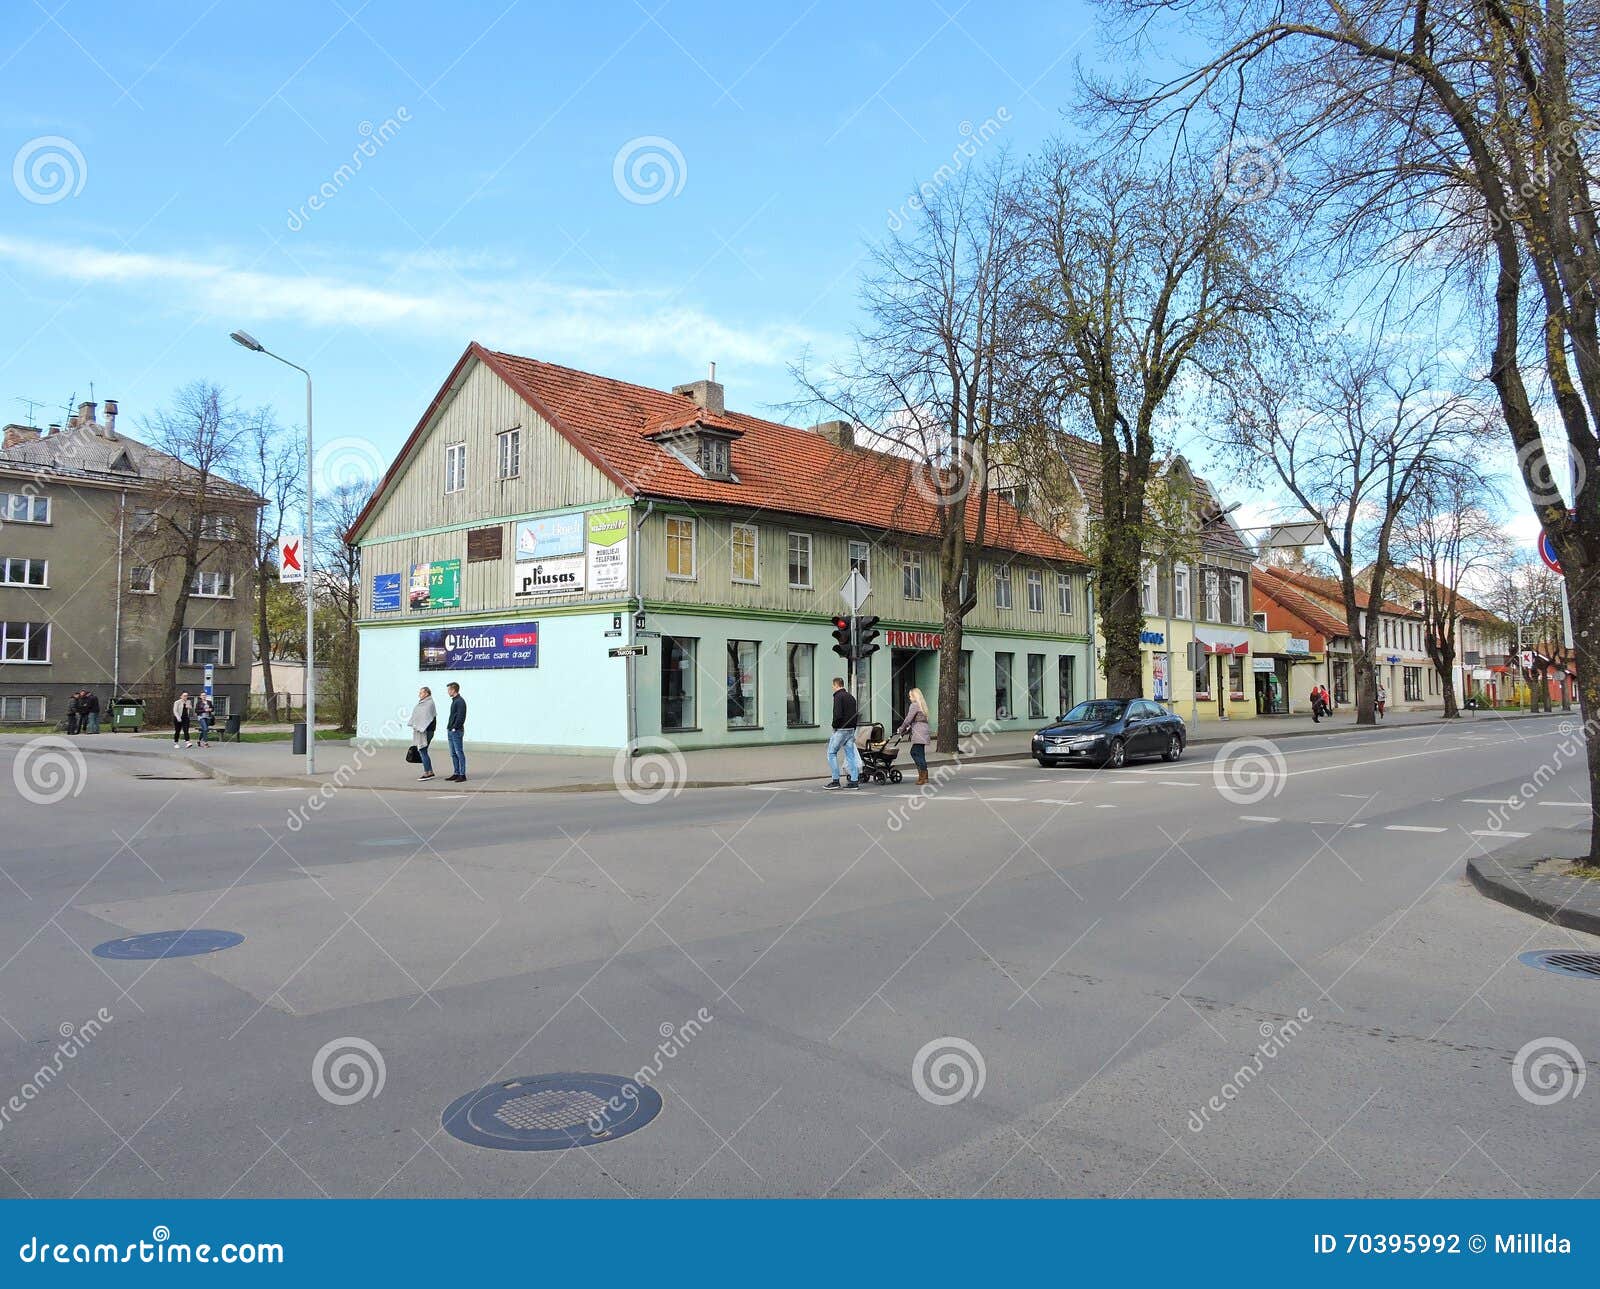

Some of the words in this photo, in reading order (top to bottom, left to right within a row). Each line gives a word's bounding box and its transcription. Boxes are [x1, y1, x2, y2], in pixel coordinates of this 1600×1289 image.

[523, 566, 575, 591] pliusas
[456, 634, 496, 649] Litorina
[464, 652, 474, 662] 25
